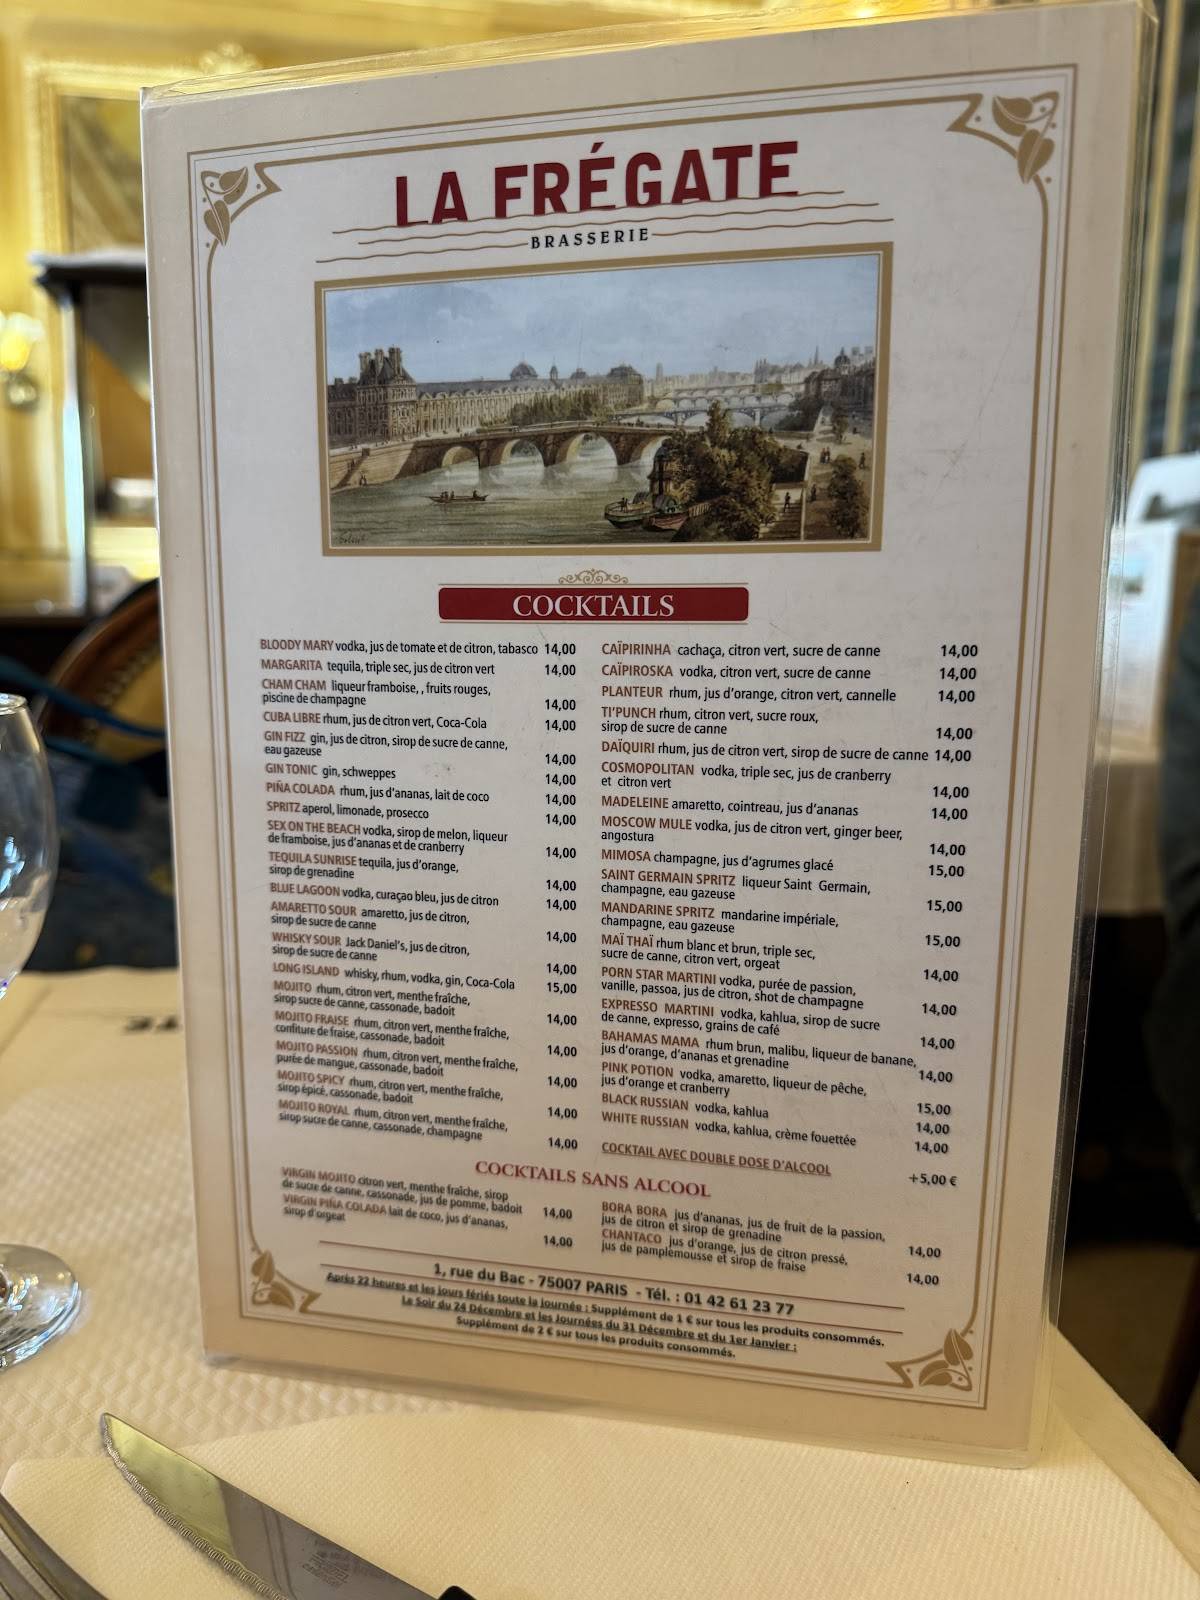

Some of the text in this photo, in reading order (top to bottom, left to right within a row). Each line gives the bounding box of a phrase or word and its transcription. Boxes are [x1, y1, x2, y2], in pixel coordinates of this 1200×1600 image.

[395, 140, 799, 227] LA FRÉGATE
[530, 227, 650, 250] BRASSERIE
[512, 594, 675, 617] COCKTAILS
[259, 639, 538, 655] BLOODY MARY vodka, jus de tomate et de citron, tabasco
[544, 643, 576, 657] 14,00
[601, 641, 880, 659] CAÏPIRINHA cachaça, citron vert, sucre de canne
[940, 646, 978, 659] 14,00
[260, 660, 494, 676] MARGARITA tequila, triple sec, jus de citron vert
[544, 664, 576, 677] 14,00
[601, 662, 870, 679] CAÏPIROSKA vodka, citron vert, sucre de canne
[940, 668, 977, 681] 14,00
[601, 686, 662, 698] PLANTEUR
[669, 686, 700, 700] rhum,
[704, 687, 720, 701] jus
[780, 688, 813, 700] citron
[816, 689, 842, 702] vert,
[846, 689, 896, 701] cannelle
[938, 691, 975, 704] 14,00
[263, 712, 486, 729] CUBA LIBRE rhum, jus de citron vert, Coca-Cola
[545, 719, 576, 733] 14,00
[265, 763, 396, 781] GIN TONIC gin, schweppes
[545, 774, 576, 787] 14,00
[266, 800, 429, 821] SPRITZ aperol, limonade, prosecco
[601, 796, 668, 809] MADELEINE
[671, 798, 723, 813] amaretto,
[727, 800, 782, 815] cointreau,
[786, 802, 802, 817] jus
[545, 814, 576, 827] 14,00
[931, 809, 968, 822] 14,00
[601, 849, 651, 863] MIMOSA
[653, 851, 719, 868] champagne,
[722, 854, 738, 869] jus
[803, 858, 833, 873] glacé
[928, 866, 965, 879] 15,00
[601, 867, 870, 895] SAINT GERMAIN SPRITZ liqueur Saint Germain,
[269, 882, 498, 906] BLUE LAGOON vodka, curaçao bleu, jus de citron
[546, 899, 576, 912] 14,00
[926, 901, 963, 914] 15,00
[272, 963, 514, 989] LONG ISLAND whisky, rhum, vodka, gin, Coca-Cola
[547, 982, 577, 995] 15,00
[601, 1092, 768, 1118] BLACK RUSSIAN vodka, kahlua
[601, 1109, 856, 1146] WHITE RUSSIAN vodka, kahlua, crème fouettée
[916, 1123, 950, 1136] 14,00
[601, 1141, 654, 1157] COCKTAIL
[657, 1146, 686, 1160] AVEC
[689, 1150, 735, 1165] DOUBLE
[738, 1154, 769, 1168] DOSE
[915, 1142, 949, 1155] 14,00
[475, 1159, 710, 1197] COCKTAILS SANS ALCOOL
[909, 1173, 957, 1187] +5,00 €
[434, 1262, 446, 1278] 1,
[449, 1267, 473, 1279] rue
[477, 1267, 495, 1282] du
[499, 1269, 524, 1285] Bac
[539, 1273, 580, 1291] 75007
[585, 1278, 627, 1296] PARIS
[647, 1285, 670, 1301] Tél.
[683, 1289, 701, 1304] 01
[706, 1292, 725, 1307] 42
[729, 1294, 747, 1309] 61
[752, 1297, 770, 1311] 23
[776, 1299, 794, 1314] 77
[456, 1315, 735, 1357] Supplément de 2 € sur tous les produits consommés.
